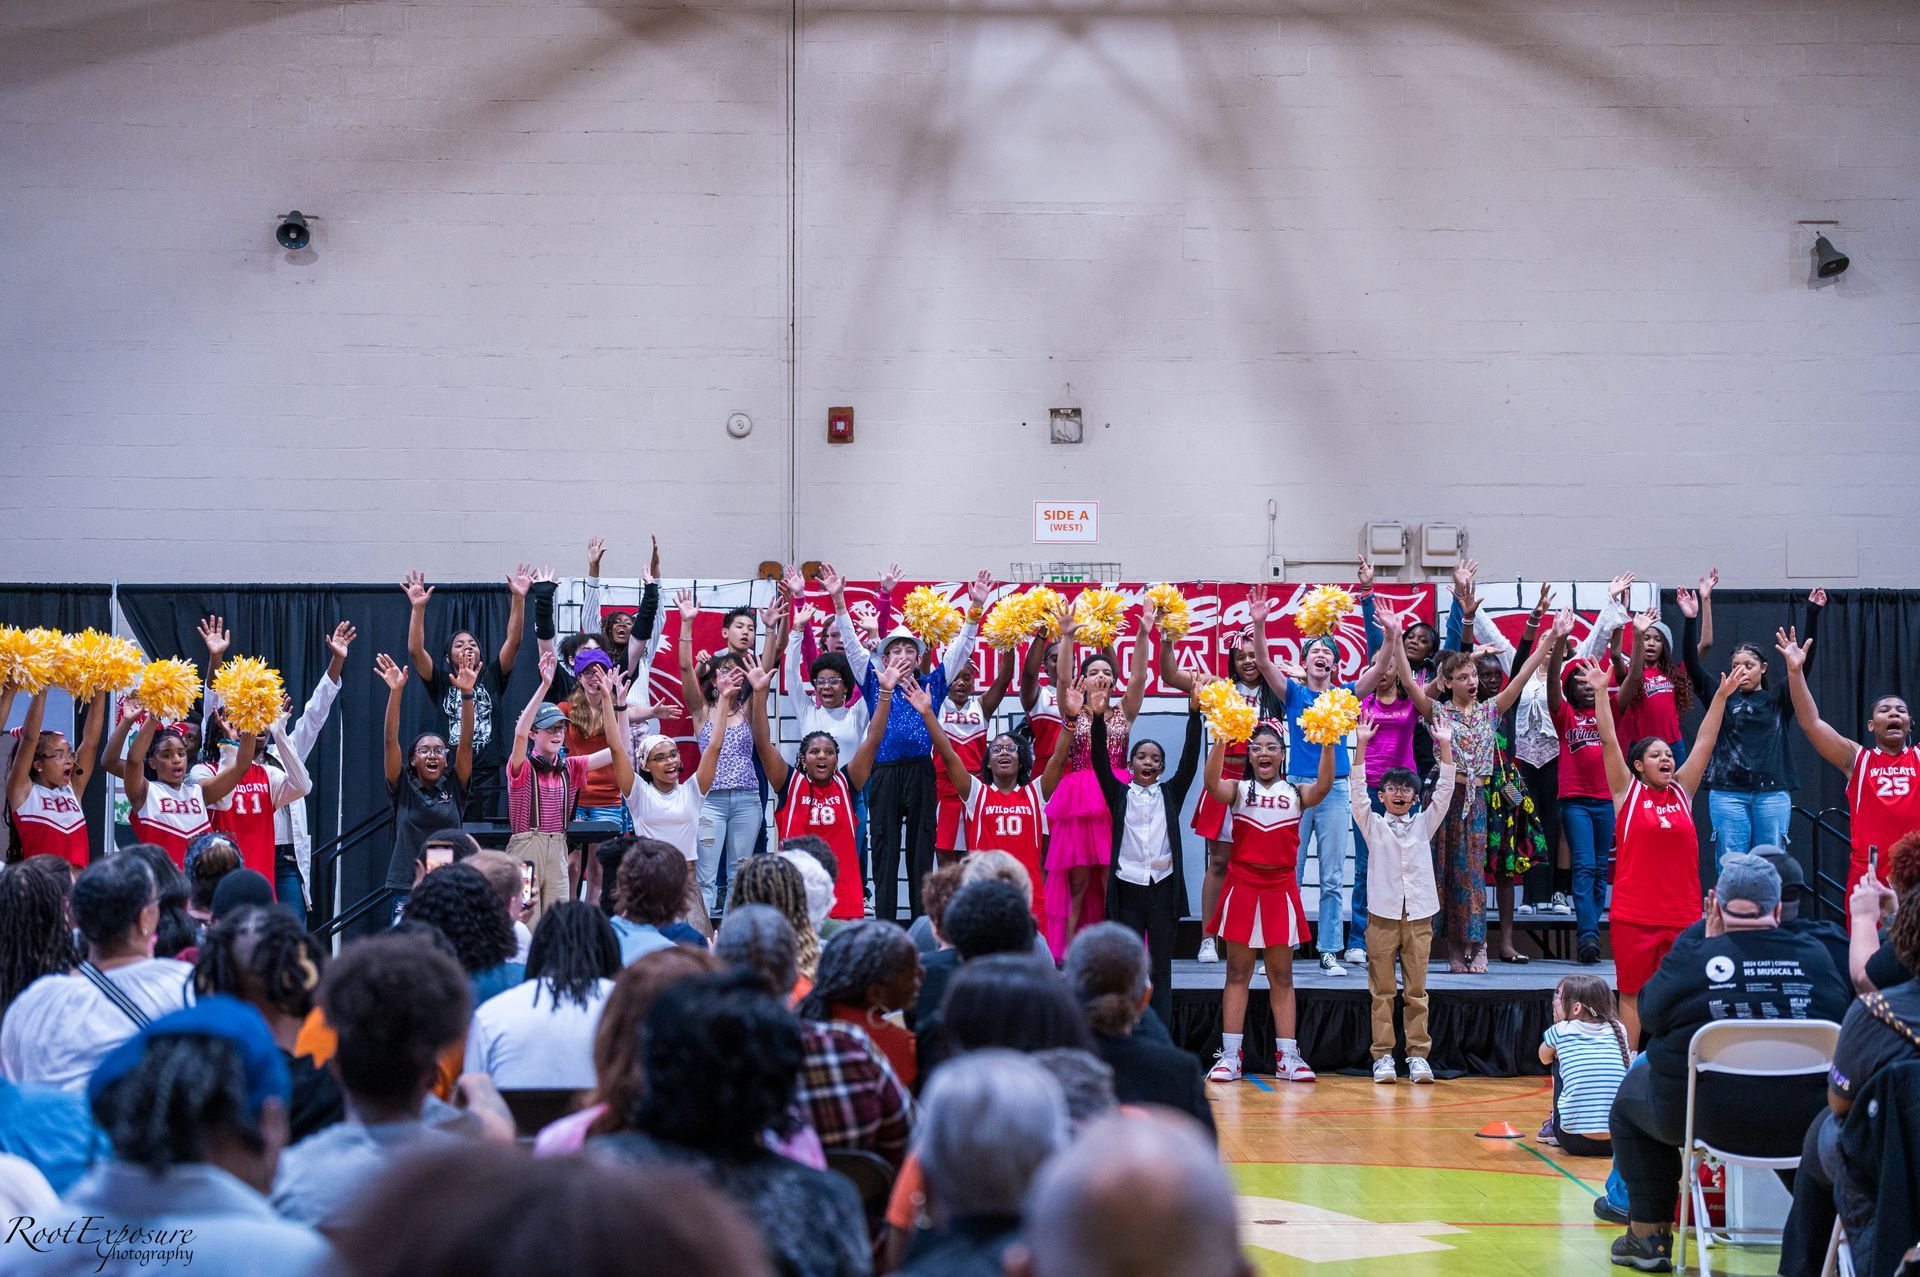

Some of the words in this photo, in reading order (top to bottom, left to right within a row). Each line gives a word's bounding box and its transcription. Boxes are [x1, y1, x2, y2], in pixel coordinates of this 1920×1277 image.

[1043, 510, 1075, 520] SIDE
[1079, 510, 1089, 520] A
[1049, 523, 1083, 532] (WEST)
[944, 711, 981, 725] EHS
[1870, 766, 1916, 777] WILDCATS
[1876, 776, 1910, 797] 25
[42, 797, 80, 812] EHS
[160, 798, 202, 814] EHS
[235, 793, 262, 814] 11
[985, 805, 1032, 815] WILDCATS
[809, 806, 835, 825] 18
[995, 815, 1023, 836] 10
[1756, 968, 1793, 976] MUSICAL
